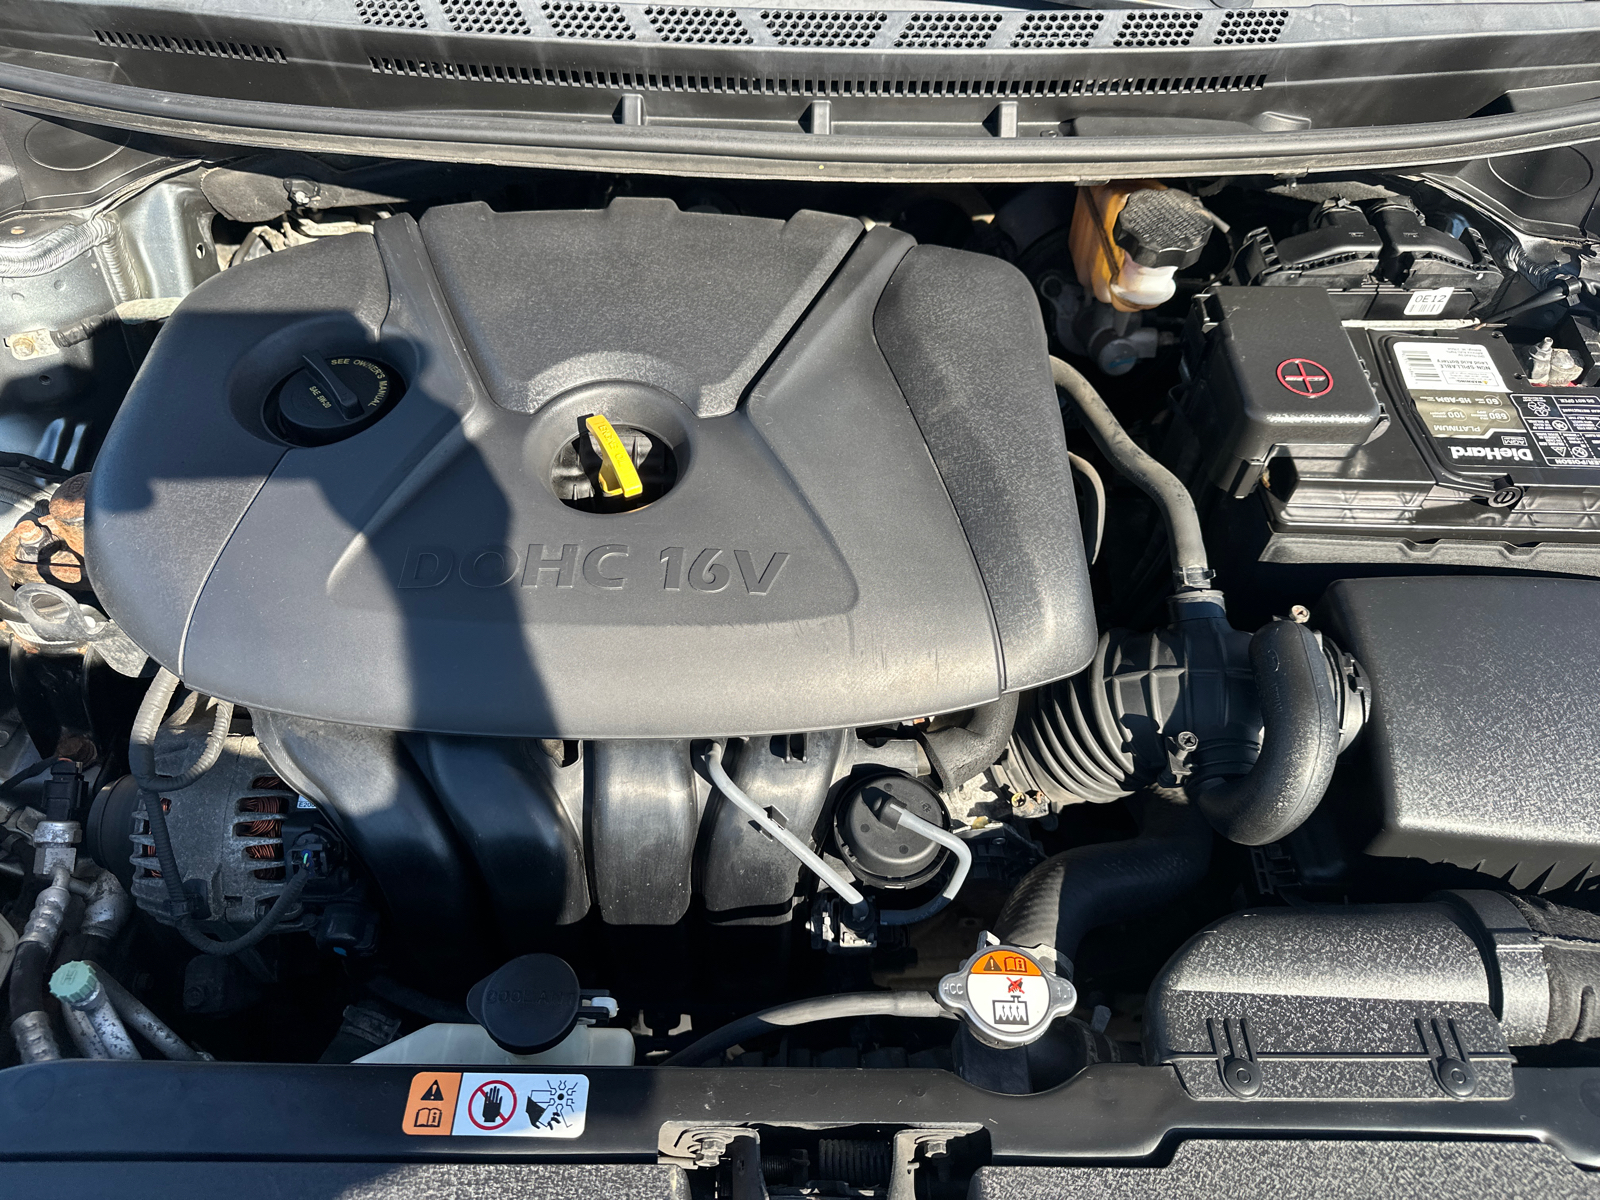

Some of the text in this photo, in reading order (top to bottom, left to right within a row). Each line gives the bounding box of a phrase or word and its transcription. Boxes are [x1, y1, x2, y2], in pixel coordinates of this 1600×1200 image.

[331, 358, 388, 407] SEE OWNER'S MANUAL
[308, 385, 332, 409] SAE 5W-20
[1447, 411, 1467, 419] 100
[1433, 424, 1481, 432] PLATINUM
[1450, 446, 1534, 461] DieHard
[397, 543, 791, 595] DOHC 16V
[942, 982, 964, 995] HCC
